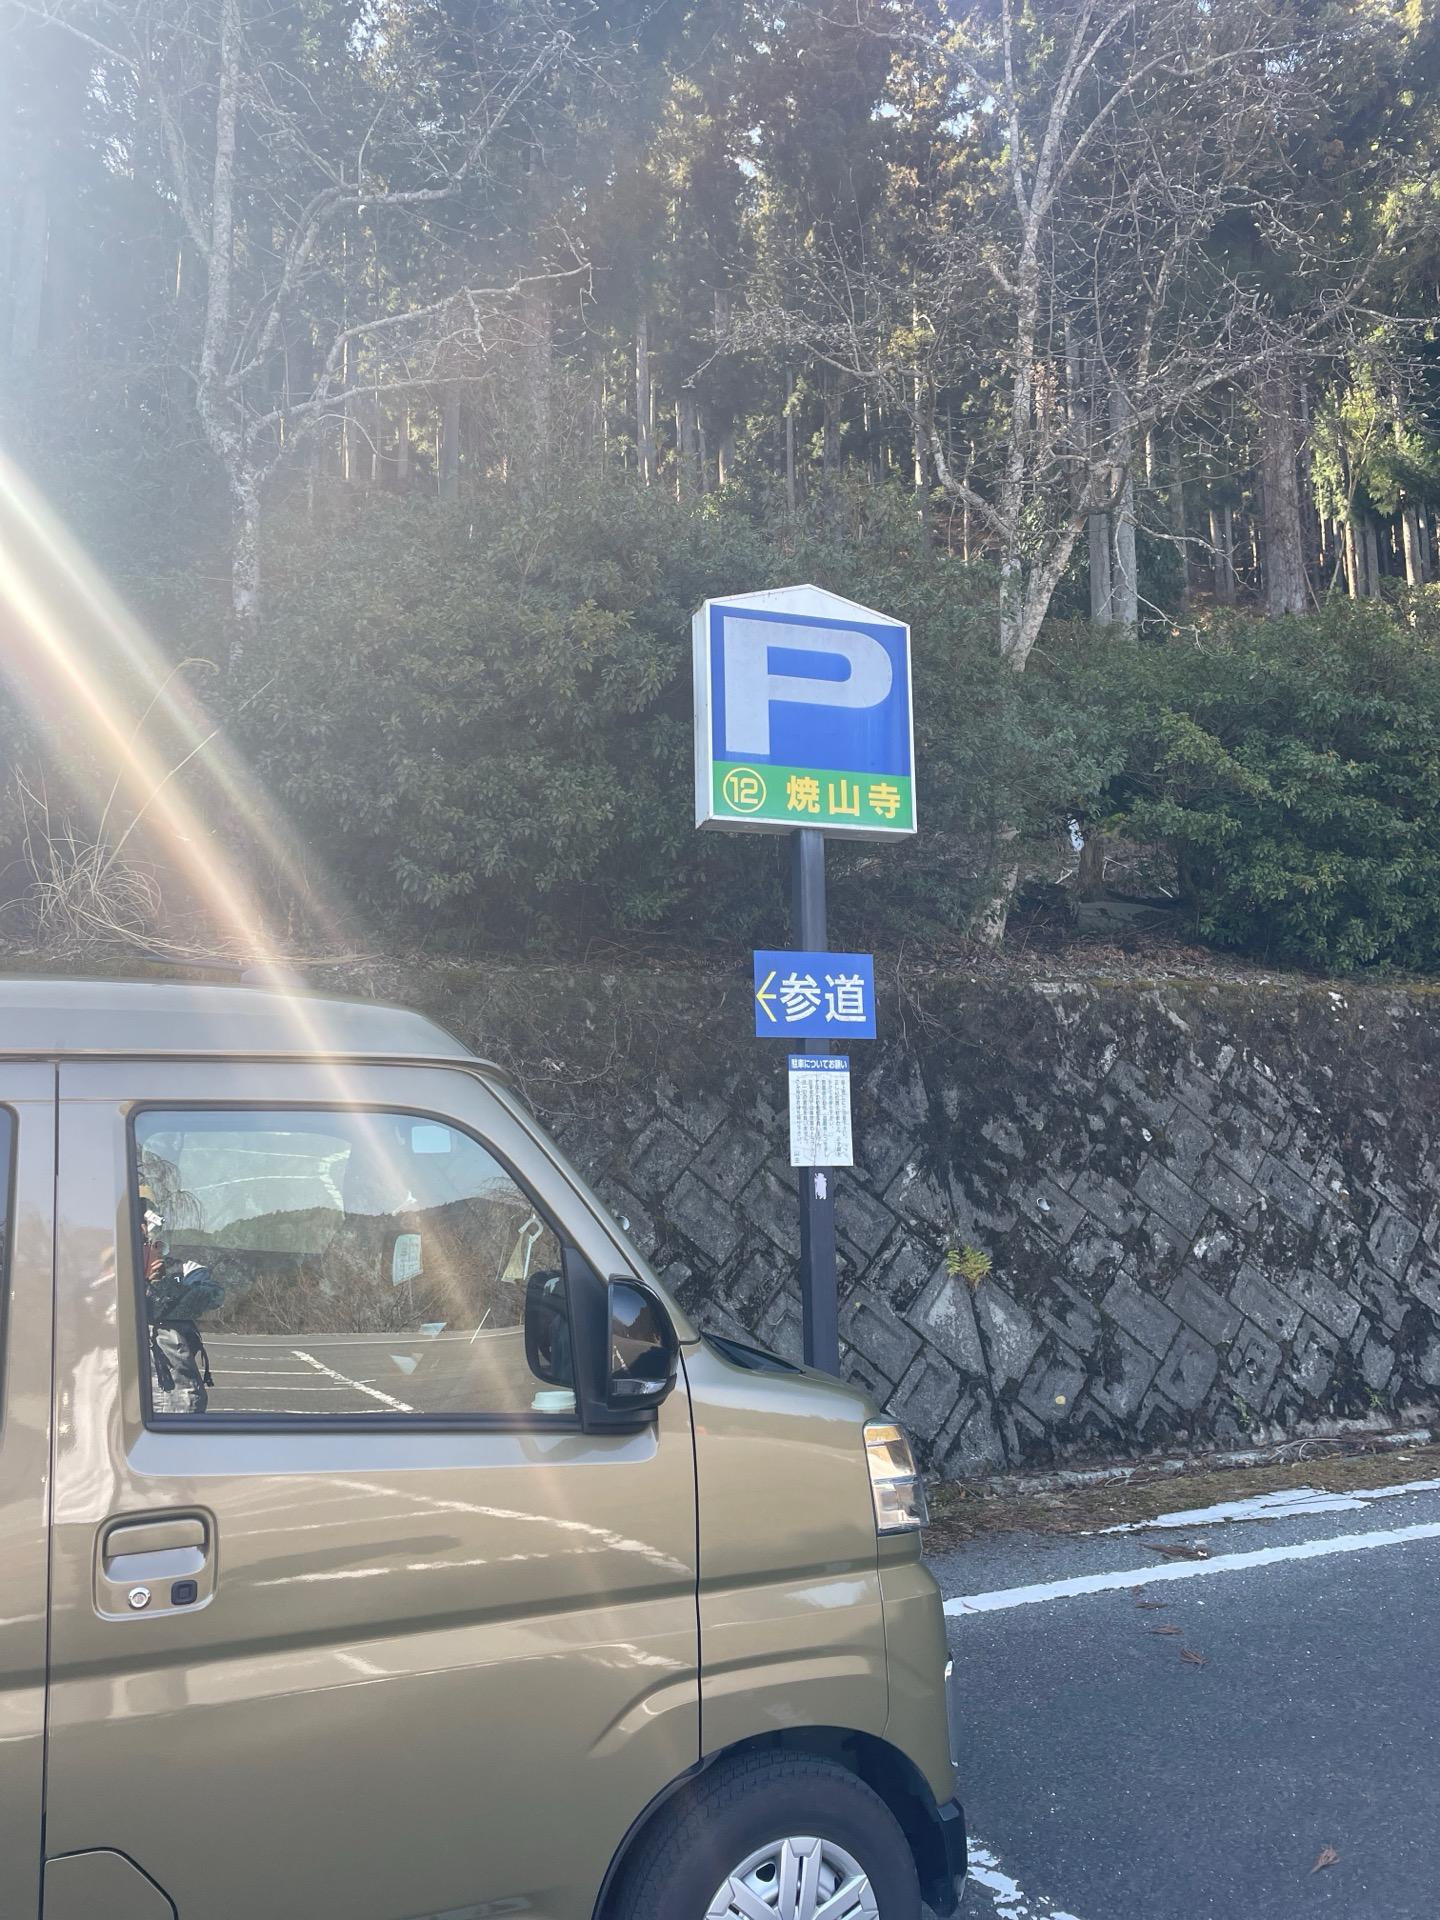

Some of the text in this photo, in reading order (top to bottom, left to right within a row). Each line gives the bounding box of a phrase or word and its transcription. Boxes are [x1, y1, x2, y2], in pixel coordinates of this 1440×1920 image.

[723, 615, 893, 756] P
[786, 774, 901, 819] 焼山寺
[779, 971, 867, 1023] 参道
